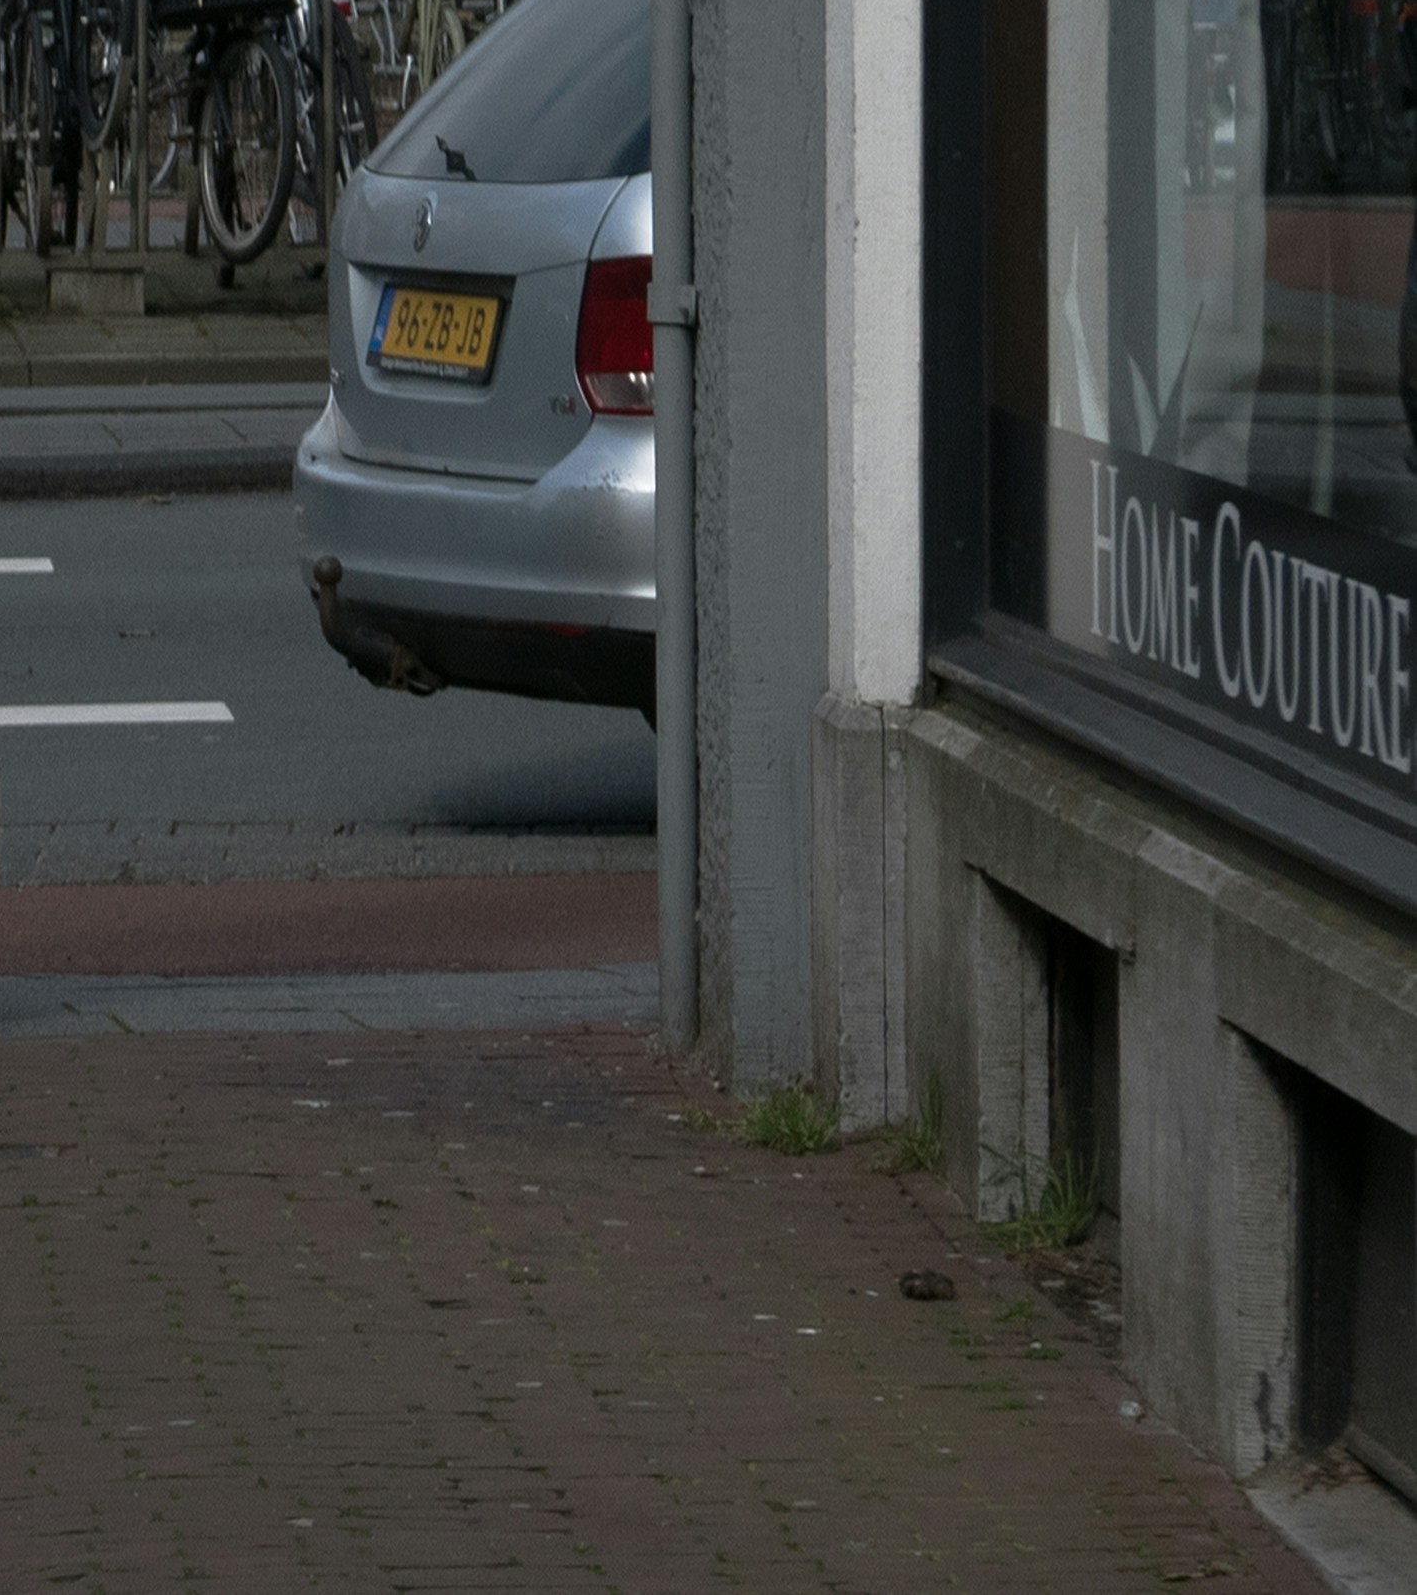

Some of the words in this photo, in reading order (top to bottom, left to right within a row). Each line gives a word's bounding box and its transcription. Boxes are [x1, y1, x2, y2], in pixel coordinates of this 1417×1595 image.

[395, 297, 486, 356] 96-ZB-JB
[1088, 459, 1202, 680] HOME
[1211, 500, 1413, 775] COUTURE
